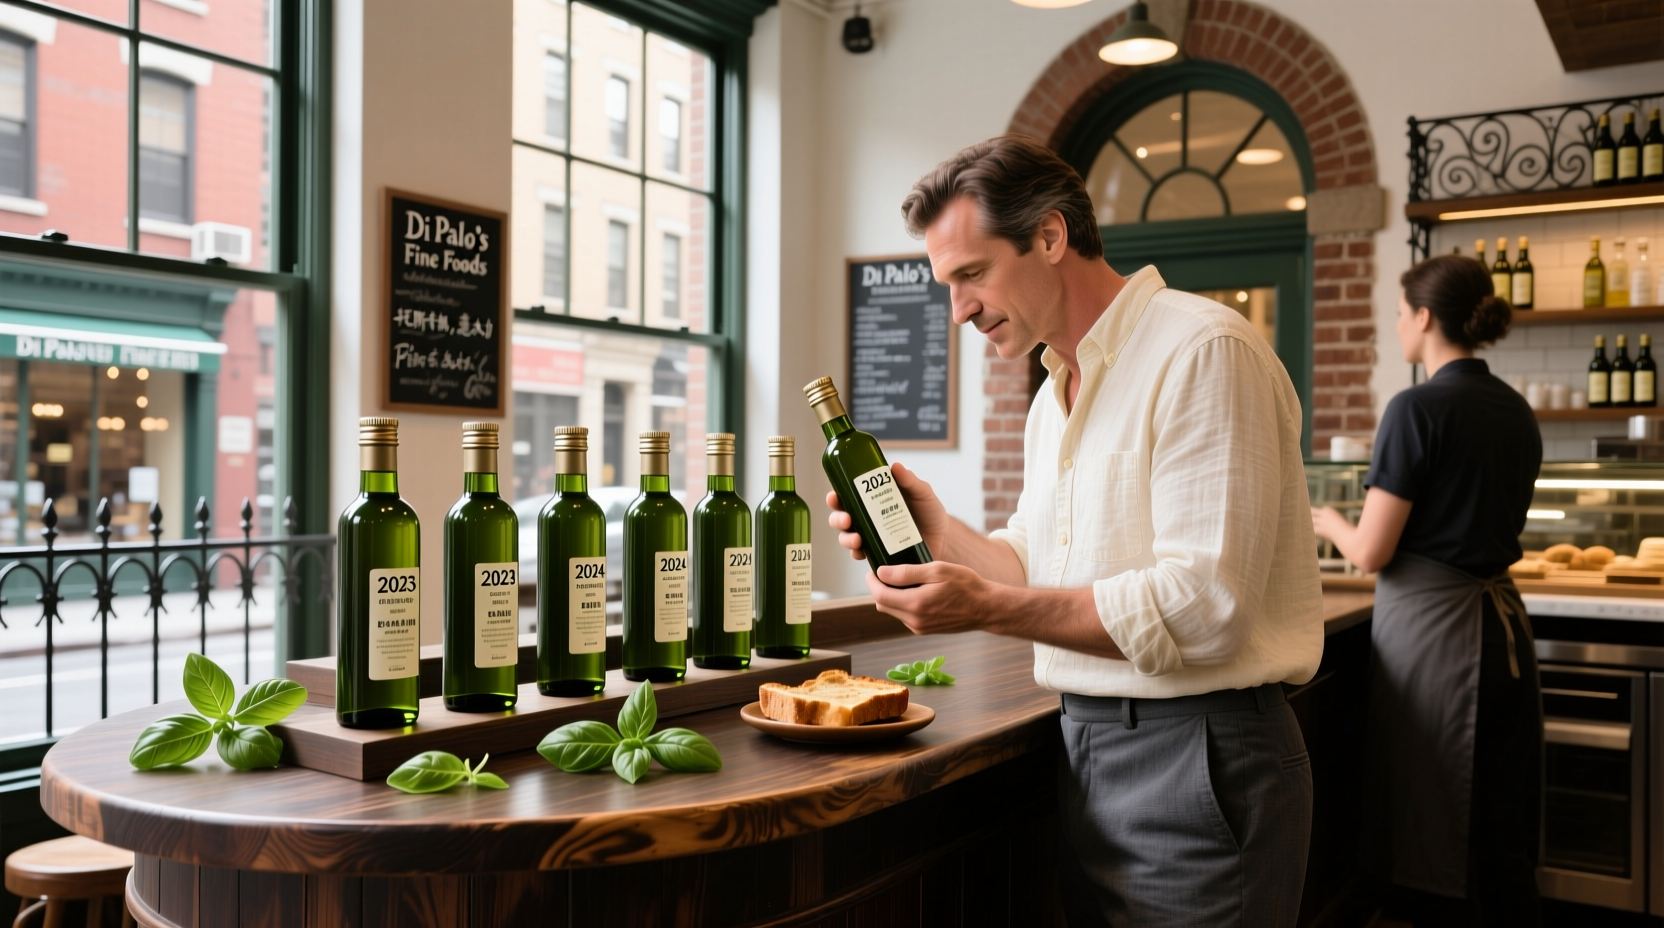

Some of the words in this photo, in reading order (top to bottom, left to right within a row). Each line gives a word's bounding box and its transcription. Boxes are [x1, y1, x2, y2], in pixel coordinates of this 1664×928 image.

[404, 210, 431, 242] Di
[434, 215, 489, 252] Palo's
[404, 242, 439, 269] Fine
[443, 249, 488, 276] Foods
[862, 265, 882, 287] Di
[885, 263, 931, 285] Palo's
[861, 471, 892, 494] 2023
[481, 569, 516, 587] 2023
[575, 563, 605, 580] 2024
[377, 575, 417, 594] 2023
